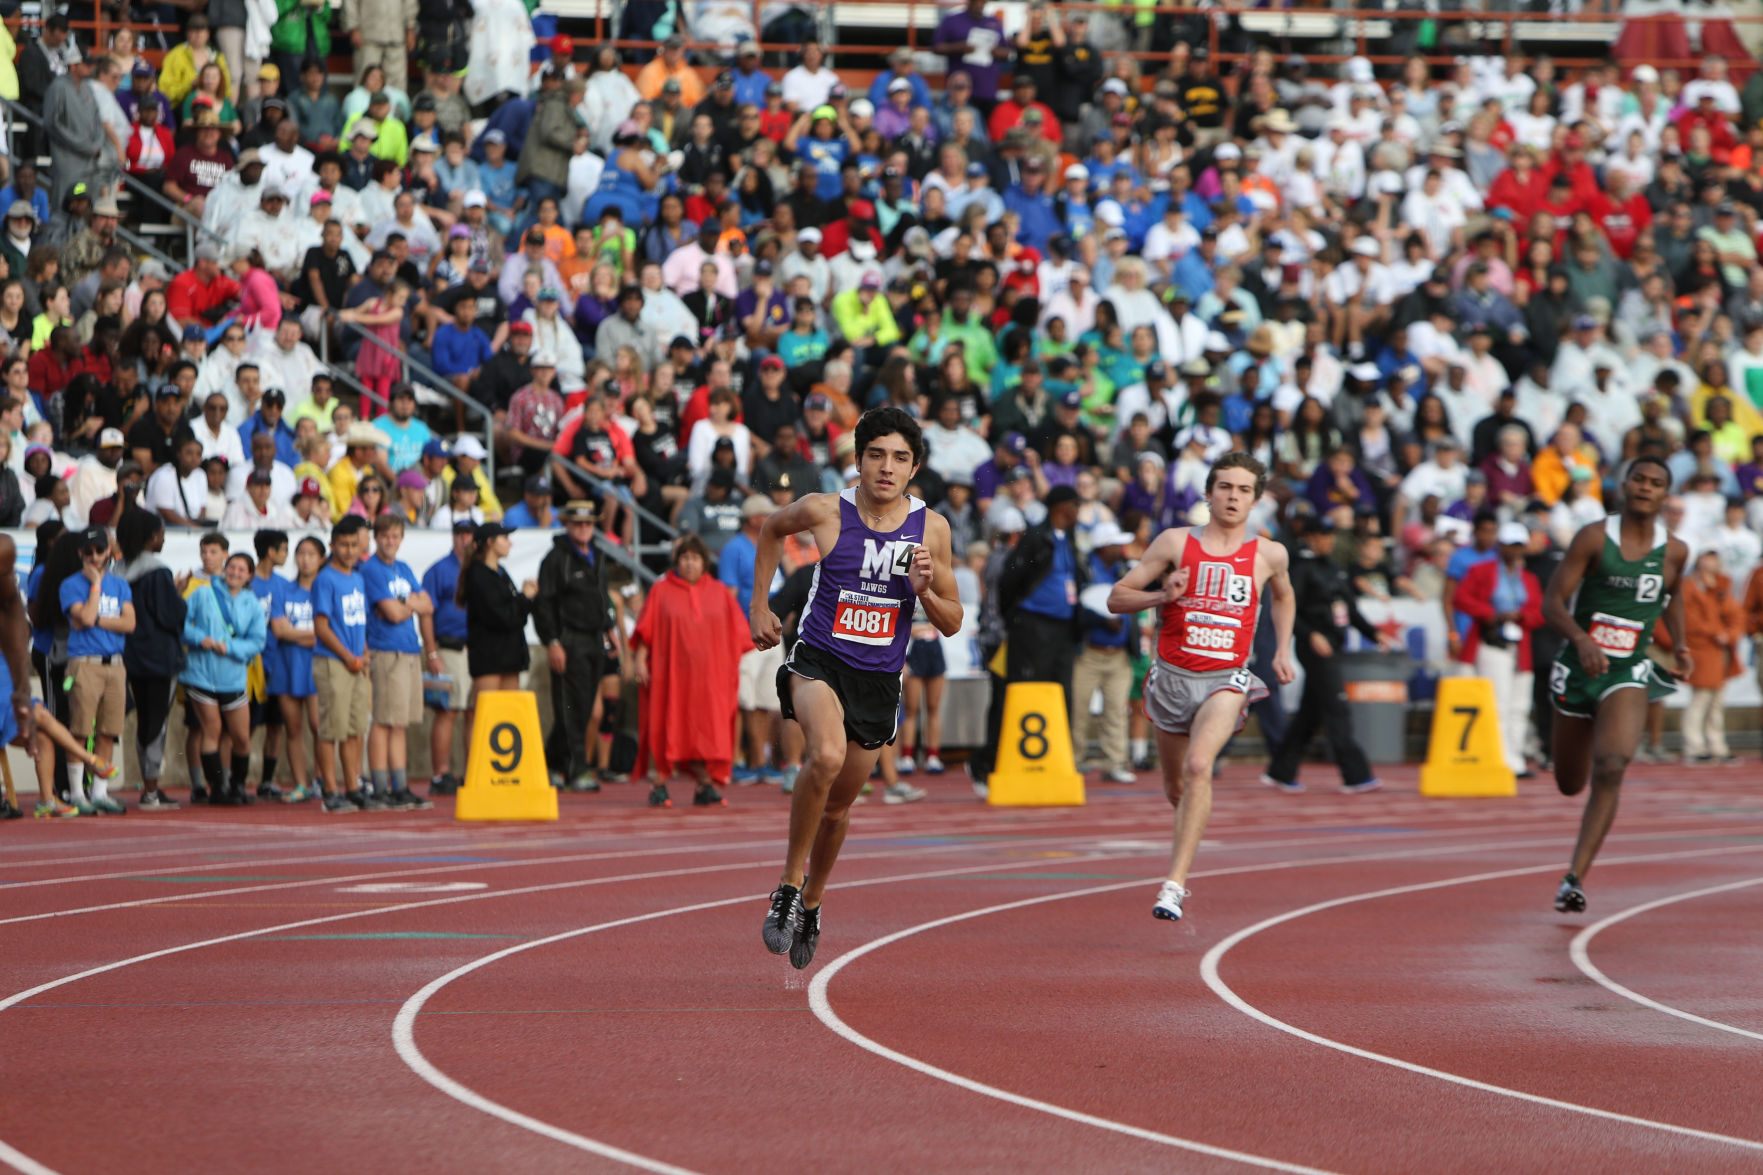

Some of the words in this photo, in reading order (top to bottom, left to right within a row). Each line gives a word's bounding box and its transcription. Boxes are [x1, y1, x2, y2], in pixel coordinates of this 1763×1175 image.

[859, 538, 895, 581] M
[895, 544, 914, 574] 4
[854, 594, 869, 602] STATE
[861, 581, 887, 594] DAWGS
[1231, 578, 1246, 603] 3
[1641, 577, 1657, 600] 2
[840, 607, 891, 634] 4081
[1185, 625, 1236, 649] 3866
[1019, 712, 1049, 760] 8
[1452, 706, 1479, 752] 7
[489, 722, 523, 773] 9
